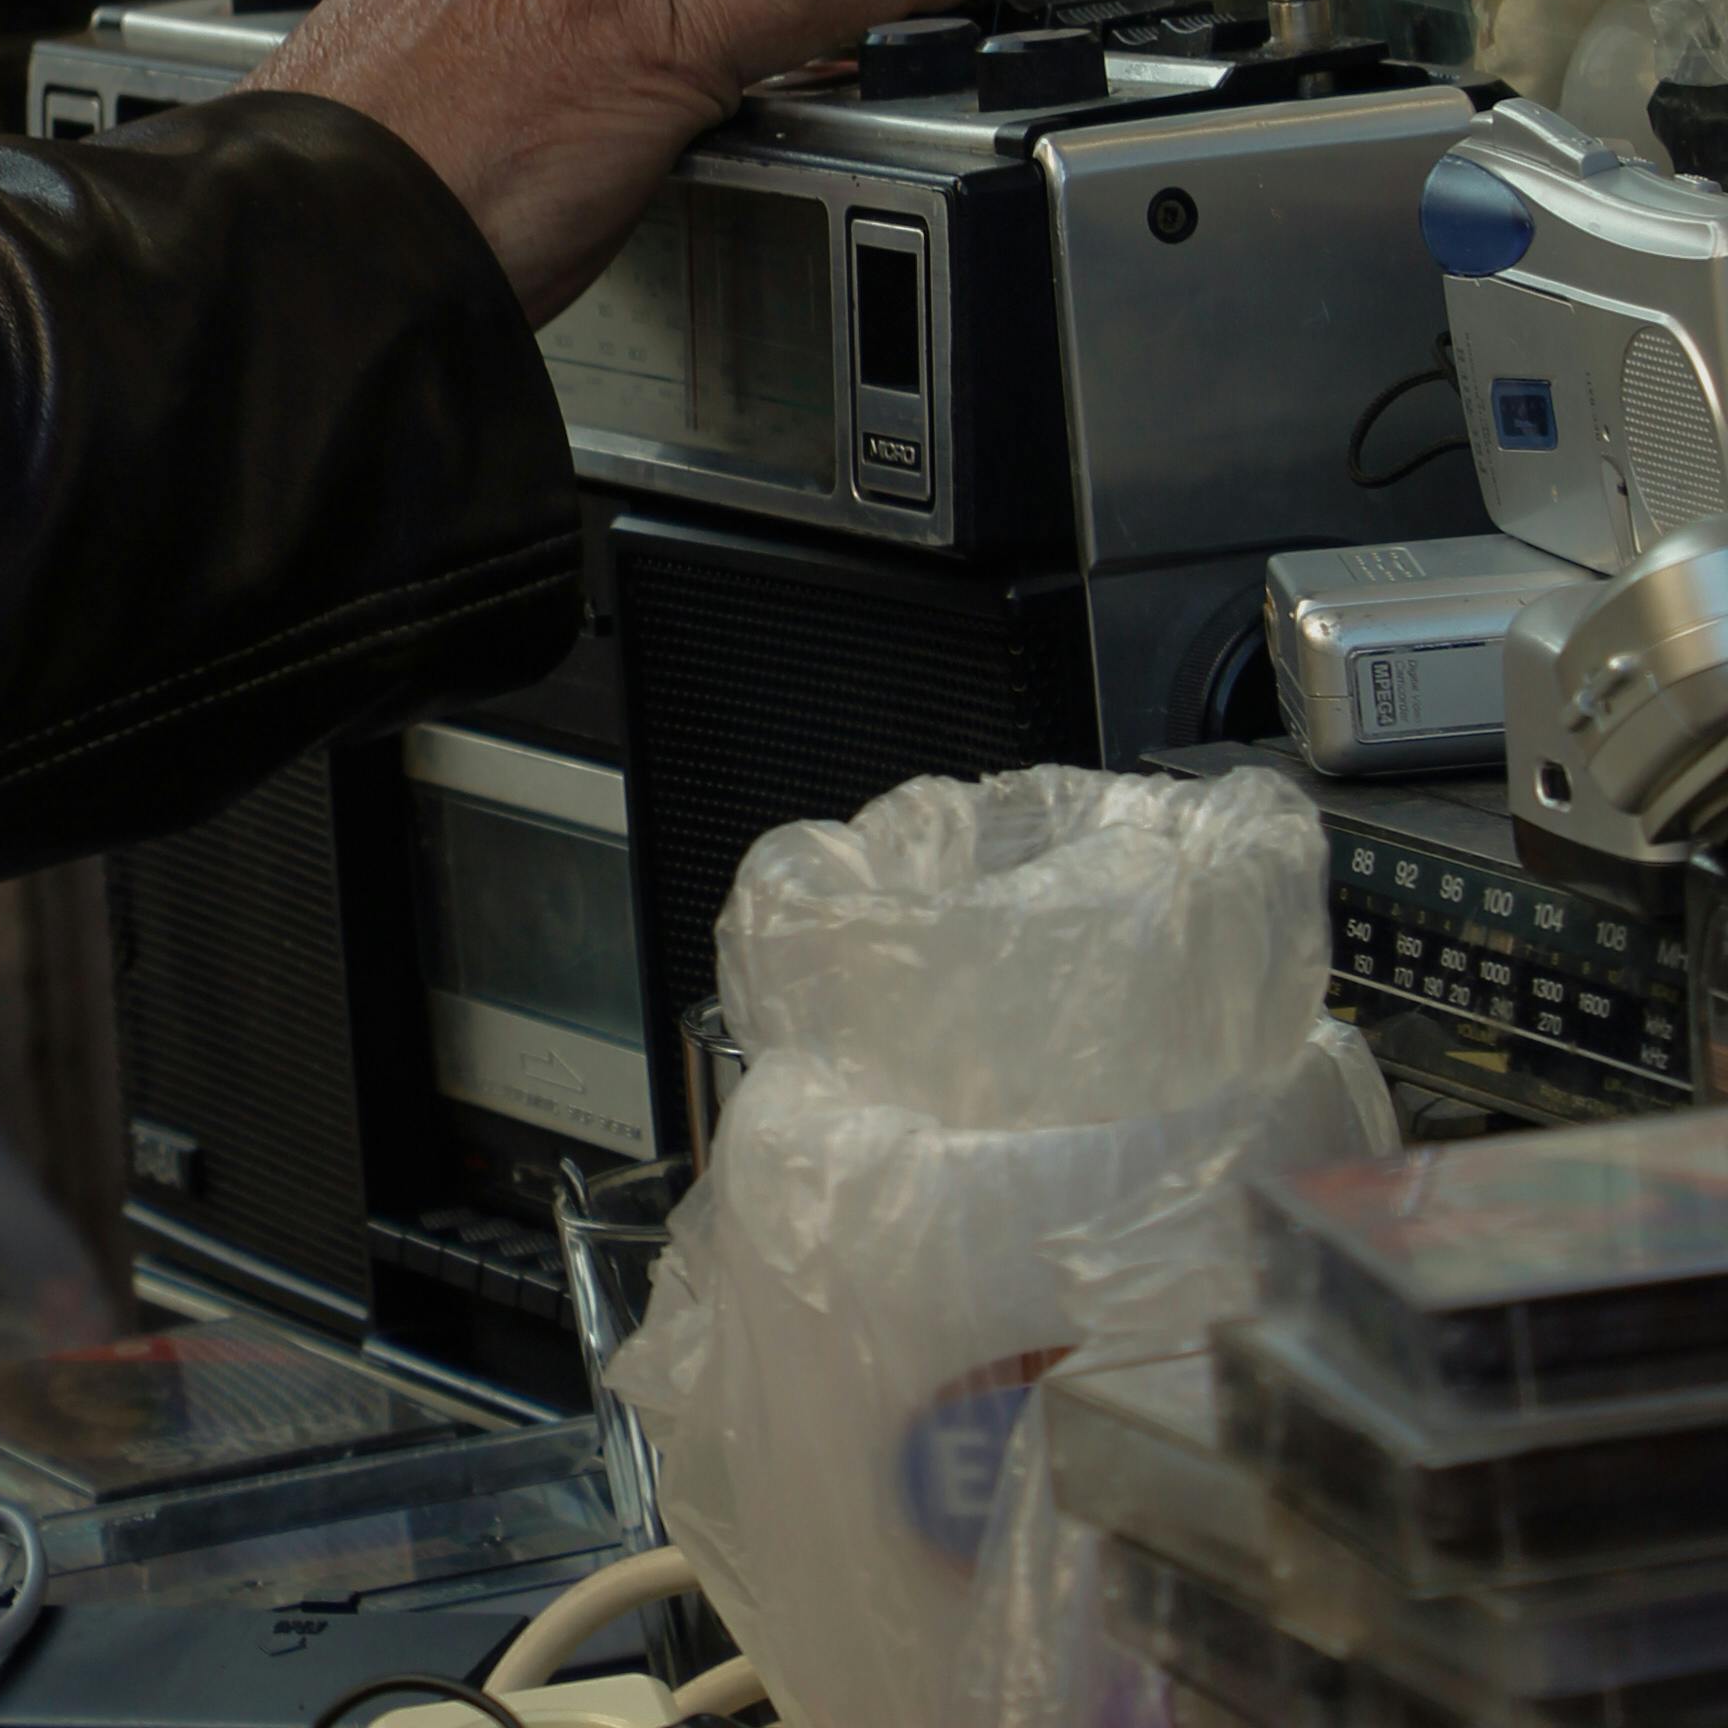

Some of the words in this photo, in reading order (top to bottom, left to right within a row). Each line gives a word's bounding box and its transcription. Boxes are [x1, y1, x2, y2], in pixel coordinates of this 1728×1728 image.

[869, 436, 917, 466] MICRO
[1373, 663, 1395, 724] MPEG4
[1351, 847, 1375, 876] 88
[1394, 860, 1419, 890] 92
[1439, 873, 1465, 903] 96
[1482, 887, 1514, 917] 100
[1533, 902, 1565, 933] 104
[1595, 919, 1628, 952] 108
[1656, 938, 1689, 971] MH
[1346, 918, 1372, 943] 540
[1396, 933, 1423, 958] 650
[1440, 947, 1467, 972] 800
[1480, 961, 1511, 986] 1000
[1532, 978, 1564, 1003] 1300
[1578, 992, 1611, 1018] 1600
[1354, 954, 1374, 975] 150
[1394, 967, 1414, 989] 170
[1424, 976, 1444, 998] 190
[1448, 984, 1471, 1007] 210
[1537, 1012, 1563, 1036] 270
[1640, 1043, 1669, 1070] kHz
